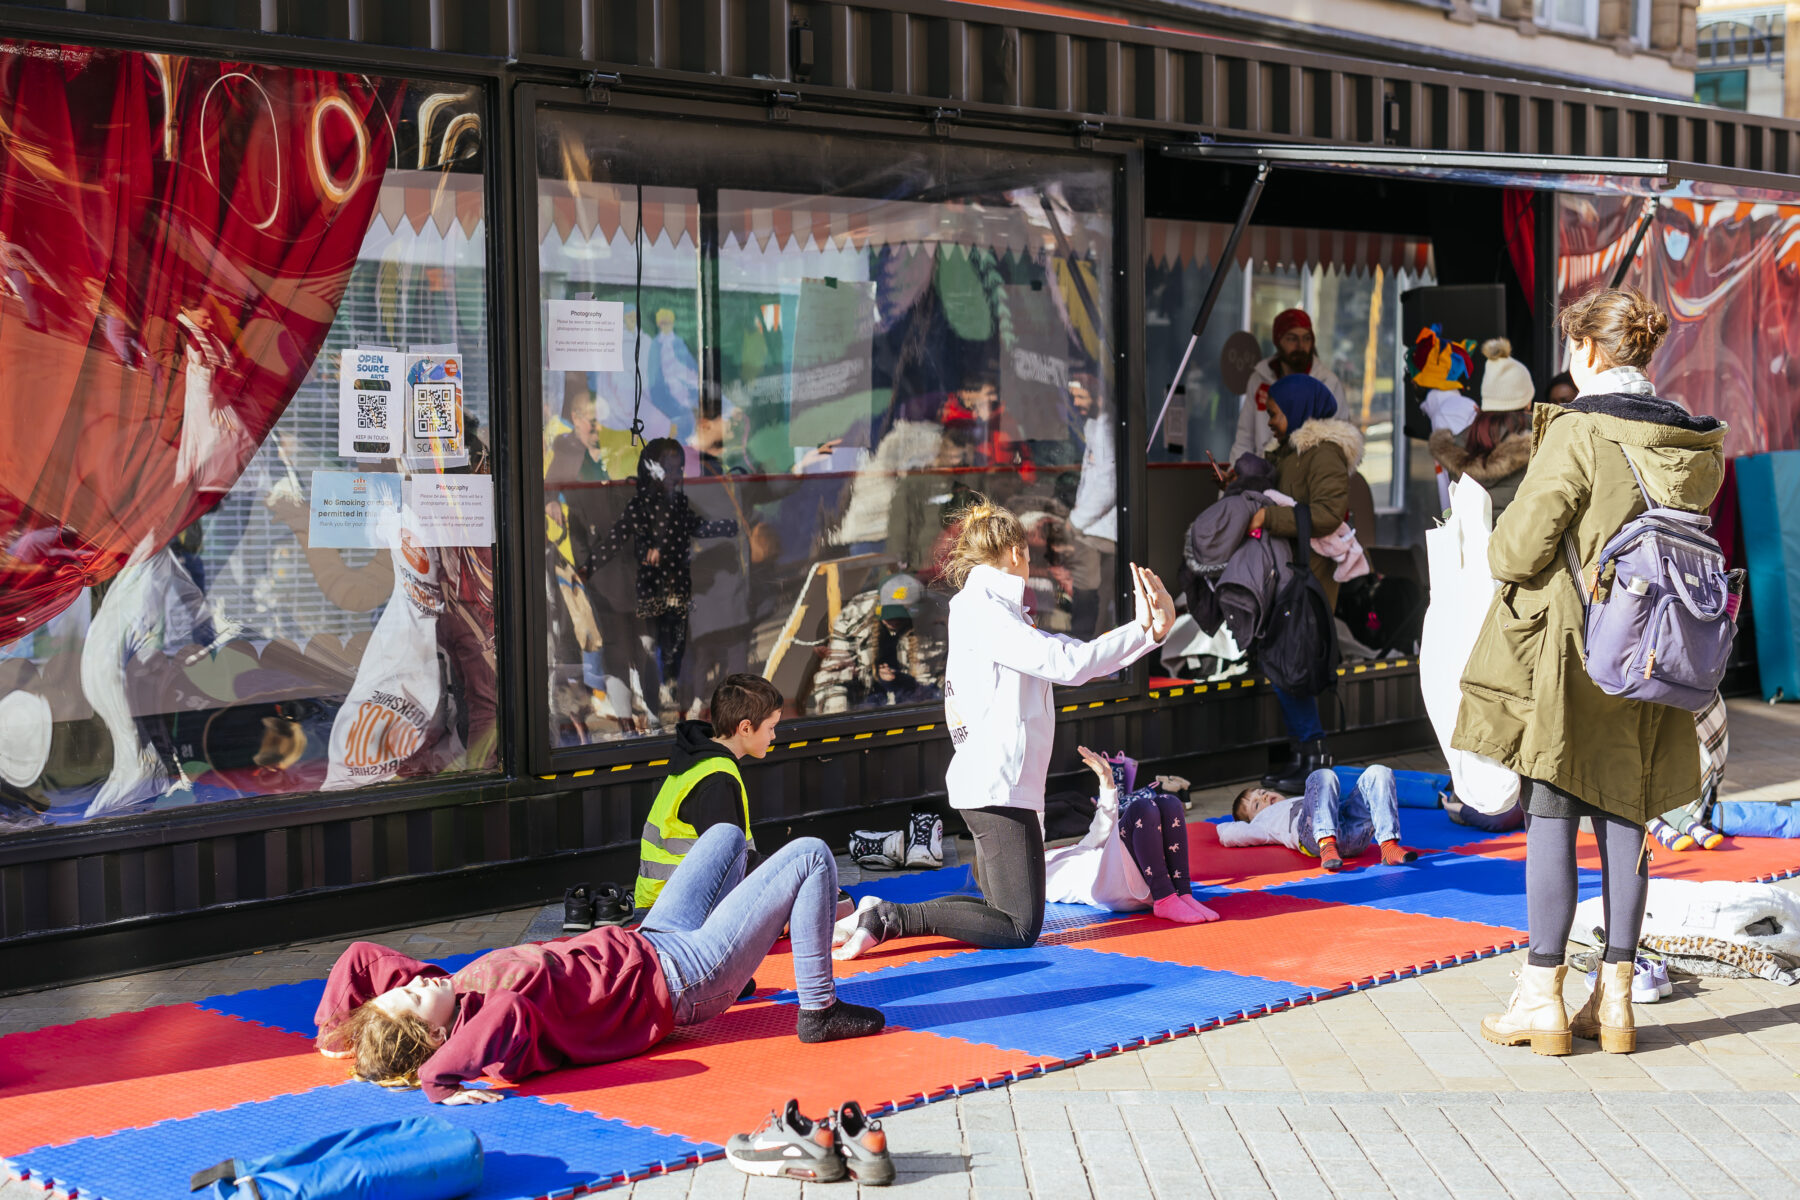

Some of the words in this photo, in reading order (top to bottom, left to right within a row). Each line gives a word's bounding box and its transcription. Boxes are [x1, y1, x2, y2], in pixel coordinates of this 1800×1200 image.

[570, 310, 602, 319] Photography
[357, 354, 384, 364] OPEN
[356, 364, 390, 373] SOURCE
[416, 442, 439, 453] SCAN
[436, 484, 469, 492] Photography
[335, 499, 366, 507] Smoking
[318, 510, 356, 519] permitted
[356, 510, 363, 518] in
